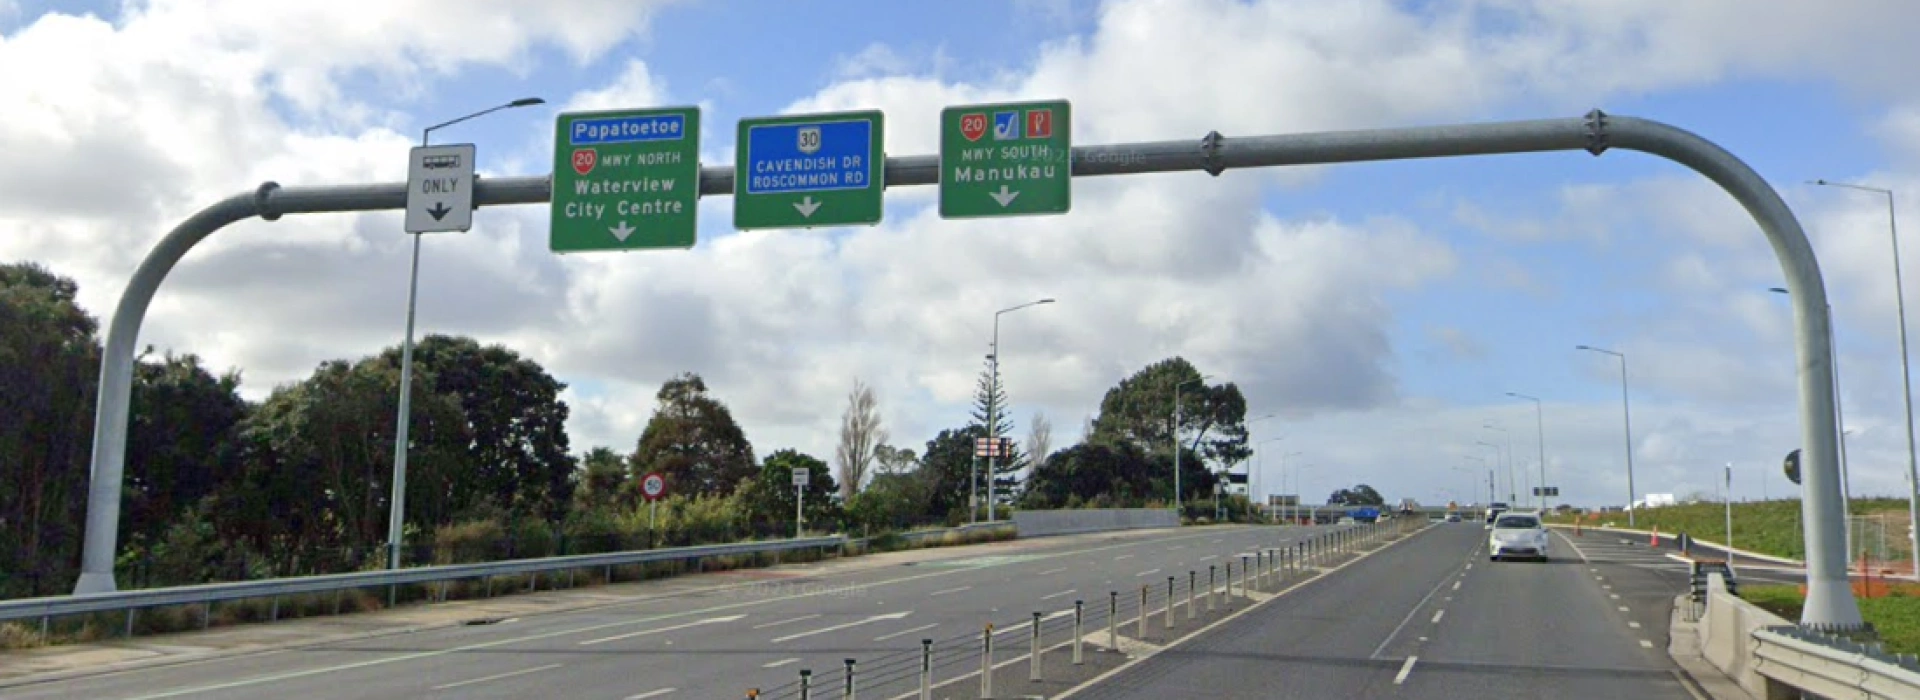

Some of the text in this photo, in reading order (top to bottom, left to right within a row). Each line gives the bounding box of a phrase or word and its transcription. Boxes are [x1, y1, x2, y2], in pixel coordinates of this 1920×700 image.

[575, 121, 679, 140] Papatoetoe
[963, 118, 983, 132] 20
[799, 132, 819, 147] 30
[575, 151, 681, 167] 20 MWY NORTH
[962, 145, 1047, 162] MWY SOUTH
[756, 154, 862, 172] CAVENDISH DR
[753, 169, 863, 189] ROSCOMMON RD
[954, 164, 1056, 182] Manukau
[422, 178, 458, 194] ONLY
[575, 176, 676, 195] Waterview
[565, 199, 683, 220] City Centre
